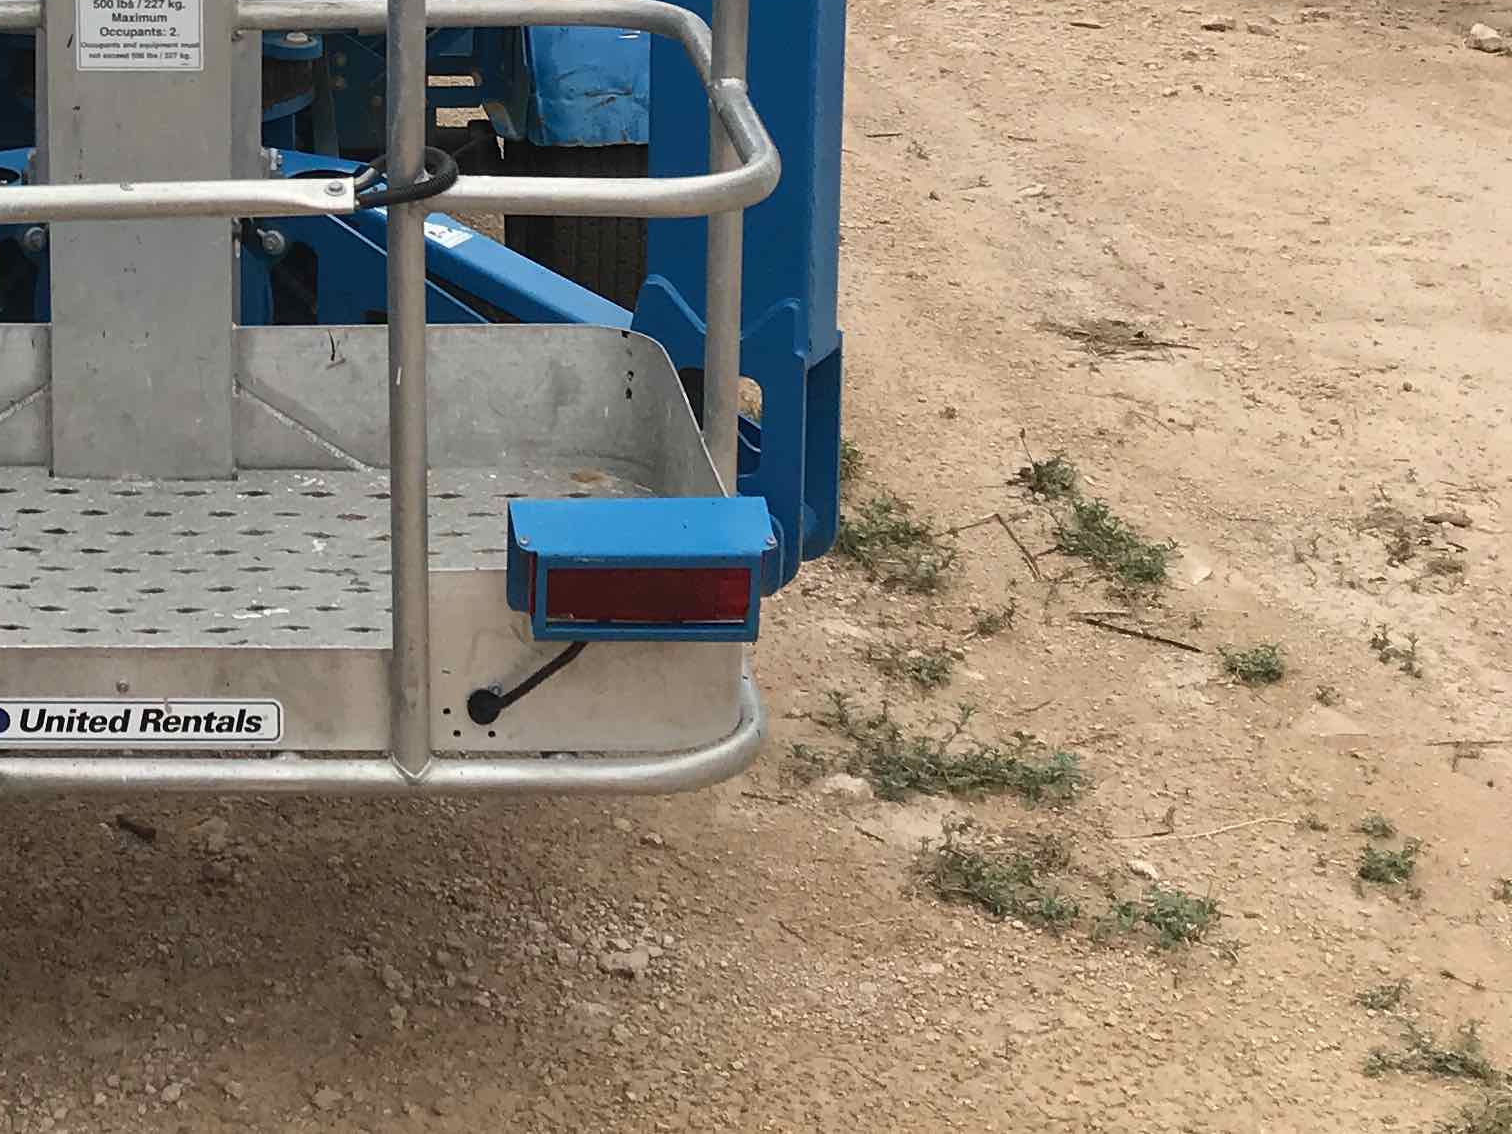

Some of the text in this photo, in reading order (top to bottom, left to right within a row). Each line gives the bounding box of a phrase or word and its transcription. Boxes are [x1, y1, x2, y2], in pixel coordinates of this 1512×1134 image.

[93, 0, 186, 11] 500 lbs / 227 kg.
[111, 12, 168, 23] Maximum
[99, 26, 167, 39] Occupants:
[19, 708, 264, 734] United Rentals
